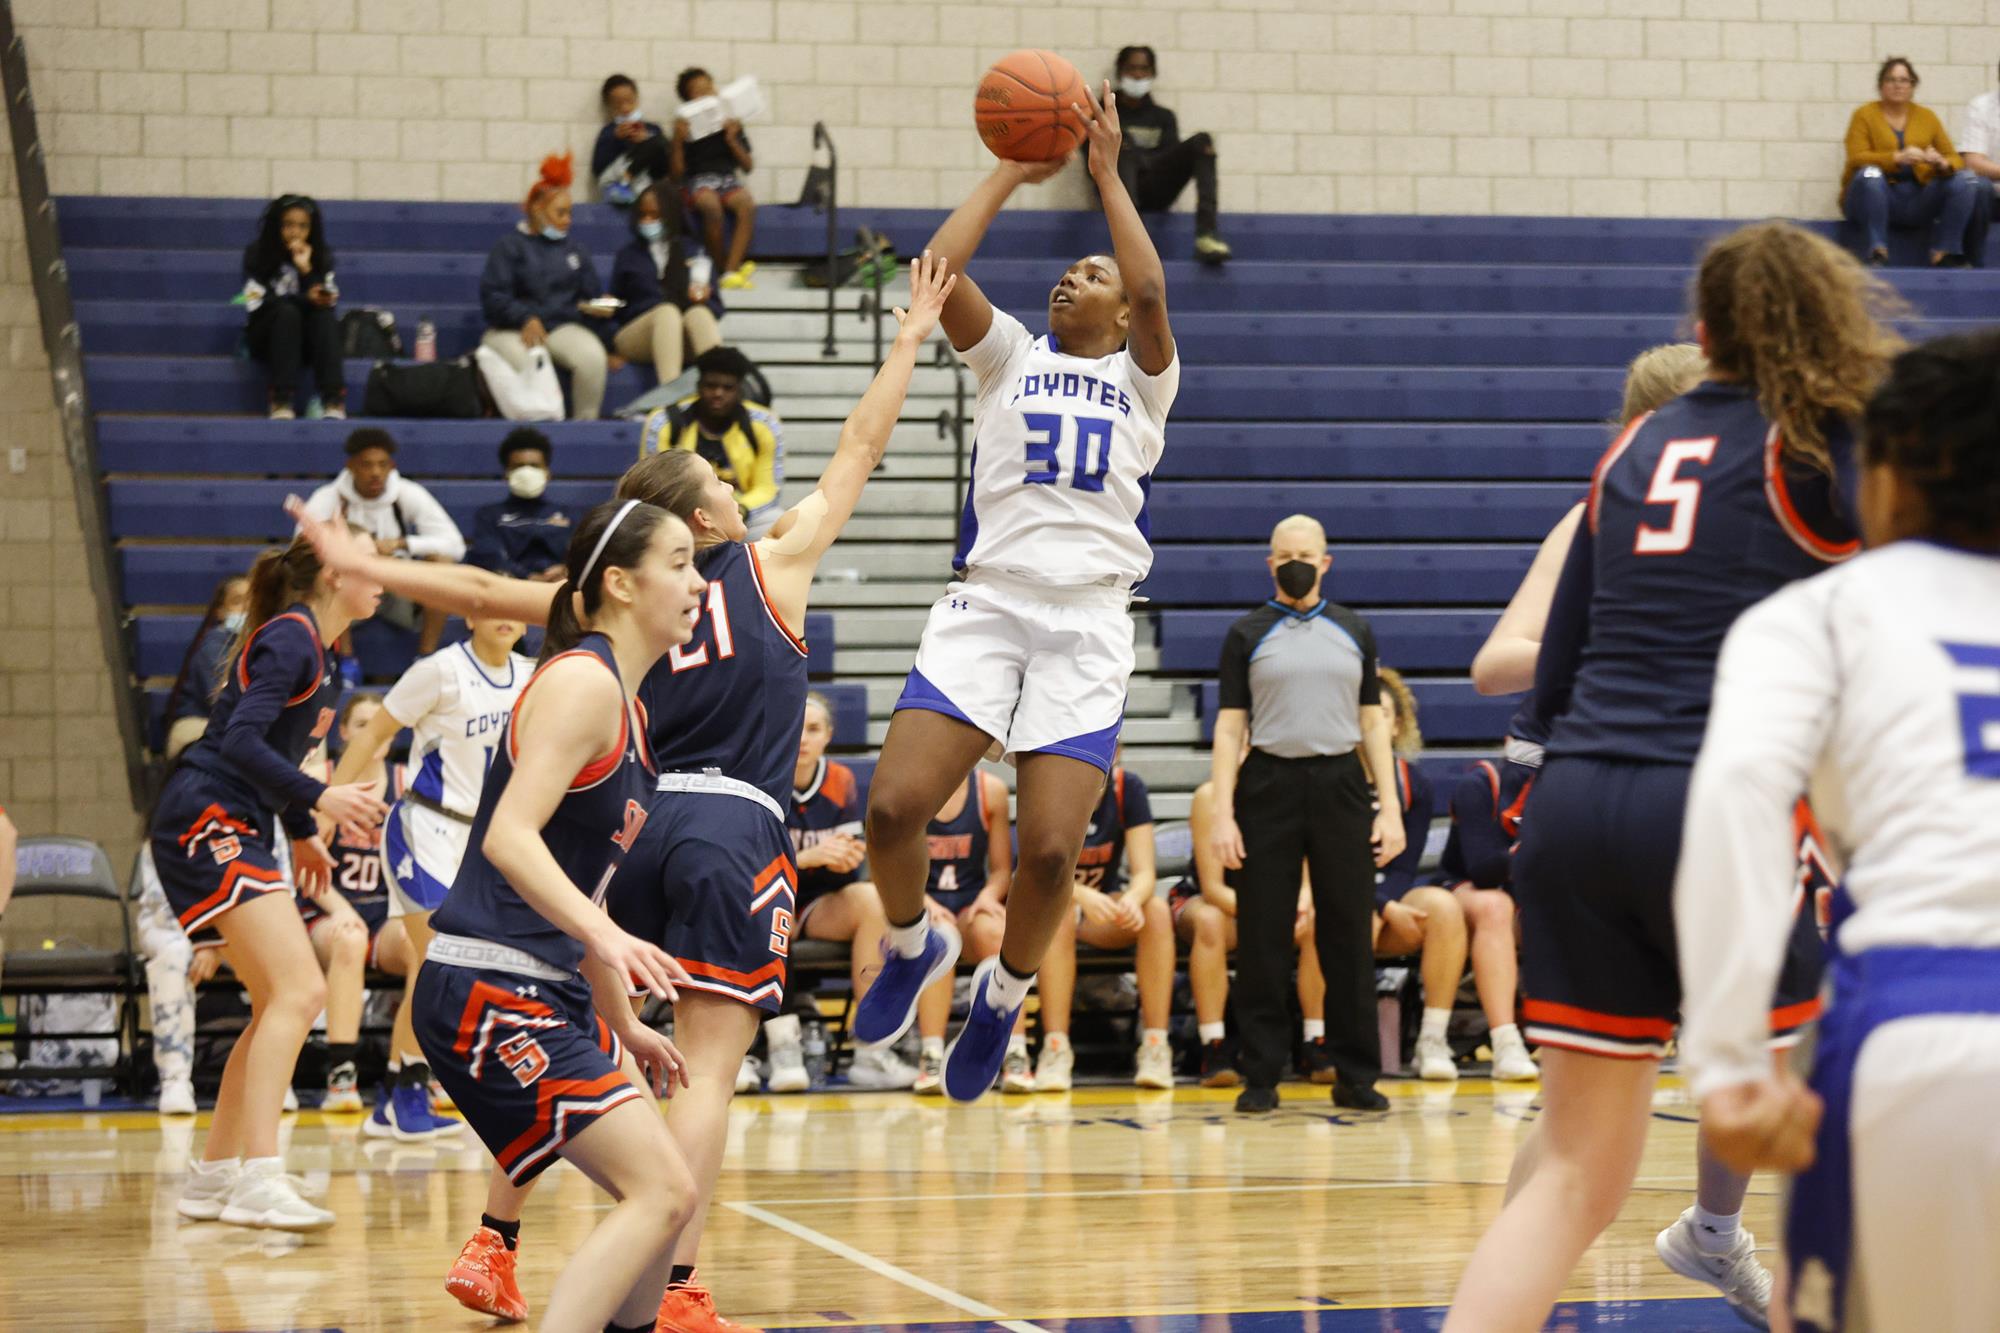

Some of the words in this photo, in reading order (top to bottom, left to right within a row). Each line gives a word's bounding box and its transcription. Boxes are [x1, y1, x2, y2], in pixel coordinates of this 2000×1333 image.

[1010, 373, 1131, 418] OYOTES
[1021, 411, 1114, 491] 30
[1633, 435, 1718, 555] 5
[466, 711, 510, 738] COYO
[340, 852, 381, 892] 20
